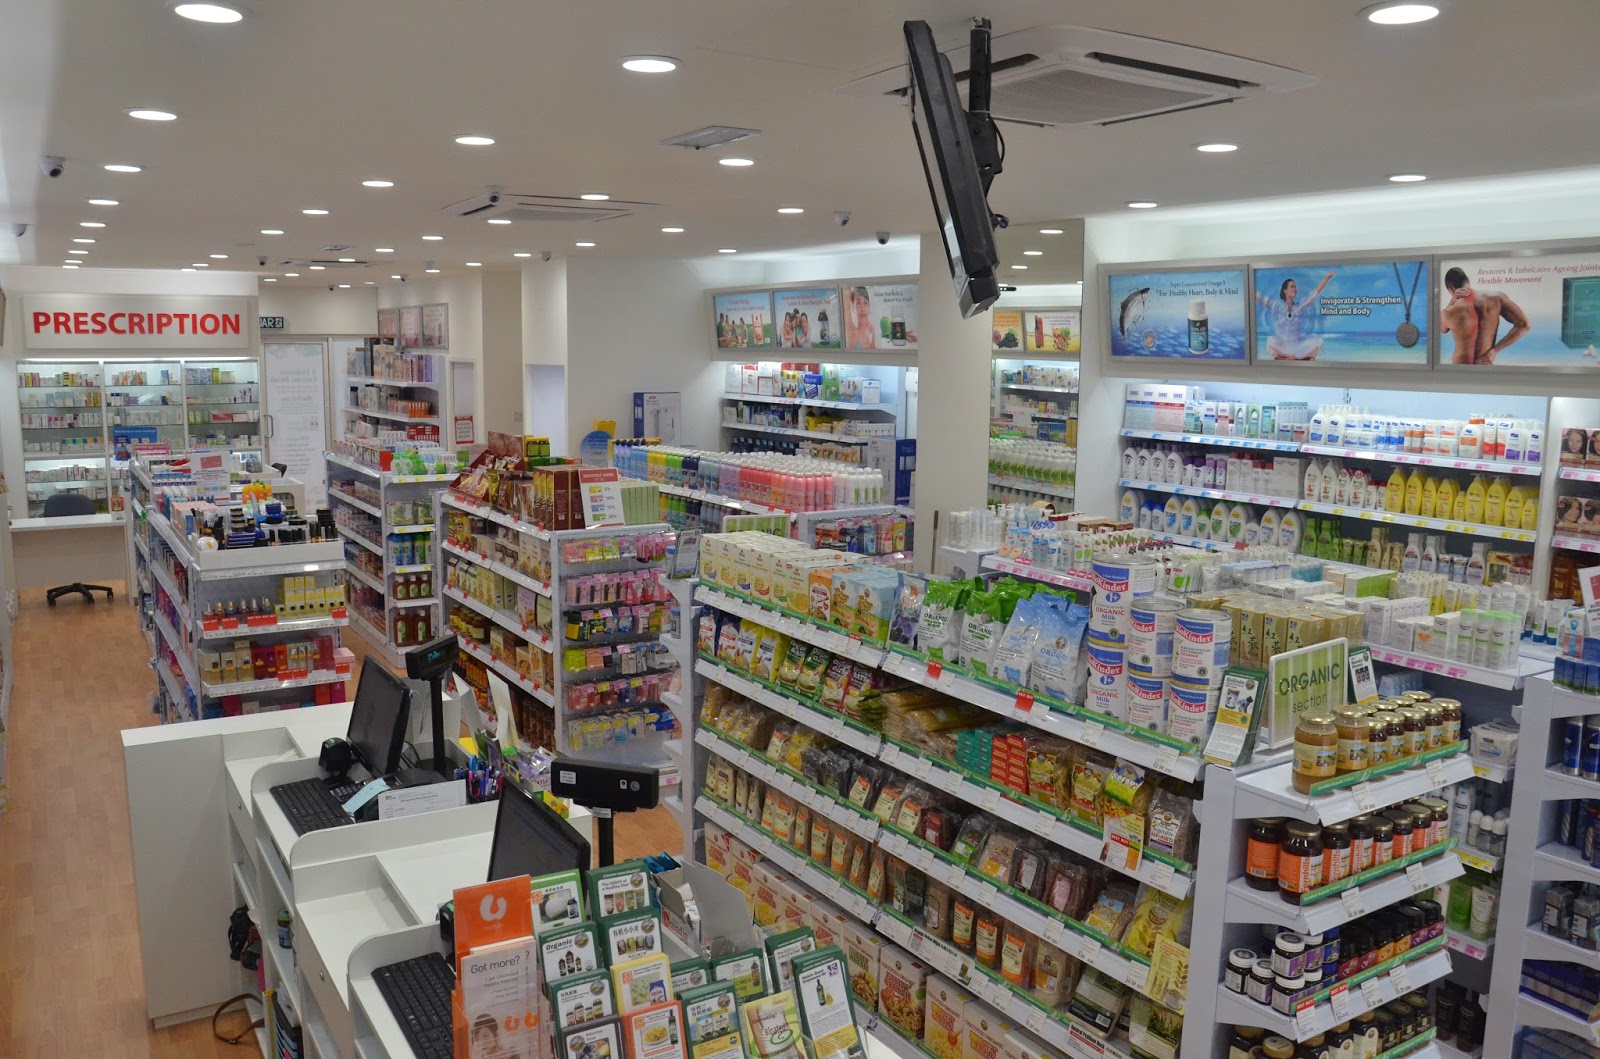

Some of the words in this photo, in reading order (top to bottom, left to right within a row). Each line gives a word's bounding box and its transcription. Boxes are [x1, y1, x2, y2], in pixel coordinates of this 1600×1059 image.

[1515, 266, 1551, 274] Lubricates
[1552, 265, 1579, 273] Ageing
[1478, 277, 1503, 285] Flexible
[1169, 289, 1188, 297] Healthy
[1205, 288, 1218, 296] Body
[1321, 296, 1354, 306] Invigorate
[1362, 296, 1401, 305] Strengthen
[1321, 307, 1338, 315] Mind
[1338, 307, 1351, 315] and
[1352, 307, 1371, 317] Body
[33, 311, 241, 335] PRESCRIPTION
[1109, 593, 1119, 602] 1+
[1095, 606, 1126, 616] ORGANIC
[923, 612, 948, 623] ORGANIC
[968, 622, 993, 636] ORGANIC
[1040, 647, 1069, 661] ORGANIC
[1103, 676, 1113, 684] 1+
[1279, 662, 1340, 696] ORGANIC
[1090, 688, 1119, 698] ORGANIC
[1292, 693, 1328, 714] section
[1301, 856, 1310, 893] Fernhills
[546, 938, 573, 951] Organic
[471, 964, 487, 974] Got
[489, 955, 520, 970] more?
